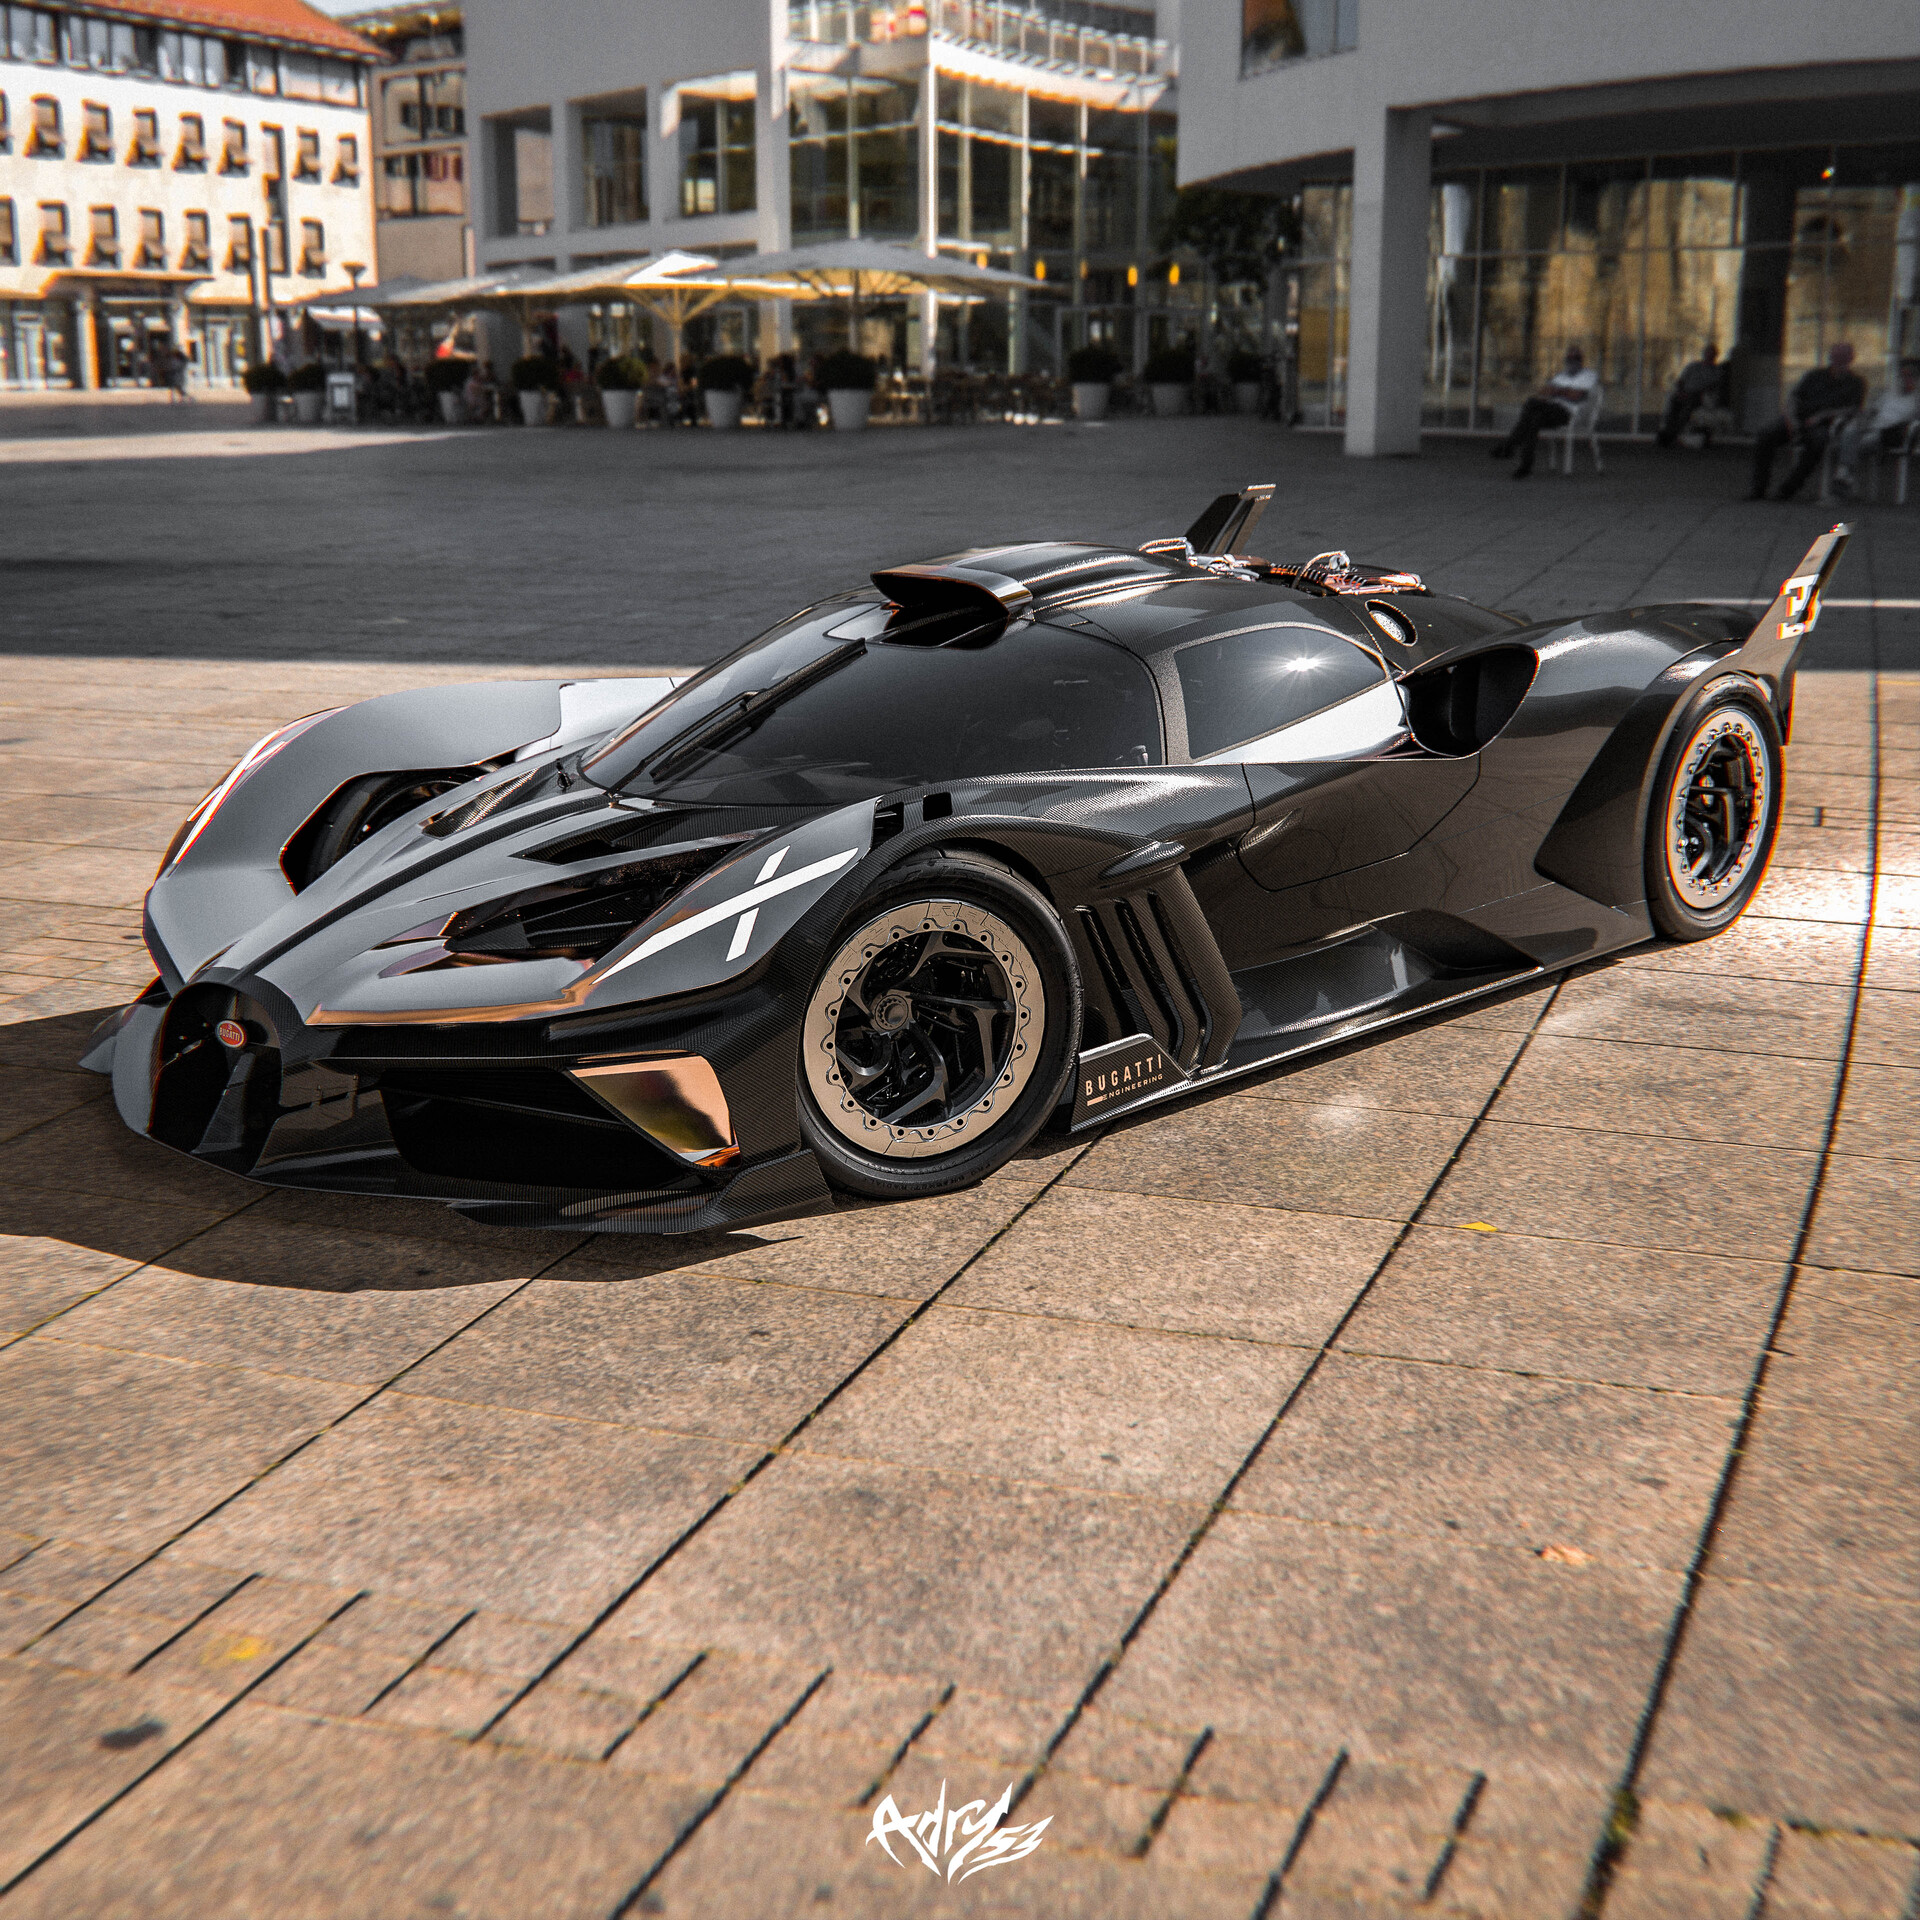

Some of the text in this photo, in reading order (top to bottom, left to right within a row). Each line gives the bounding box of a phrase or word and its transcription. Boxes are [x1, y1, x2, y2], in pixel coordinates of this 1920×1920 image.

[219, 1027, 240, 1042] BUGATTI
[1085, 1053, 1162, 1096] BUGATTI
[1100, 1073, 1163, 1101] ENGINEERING
